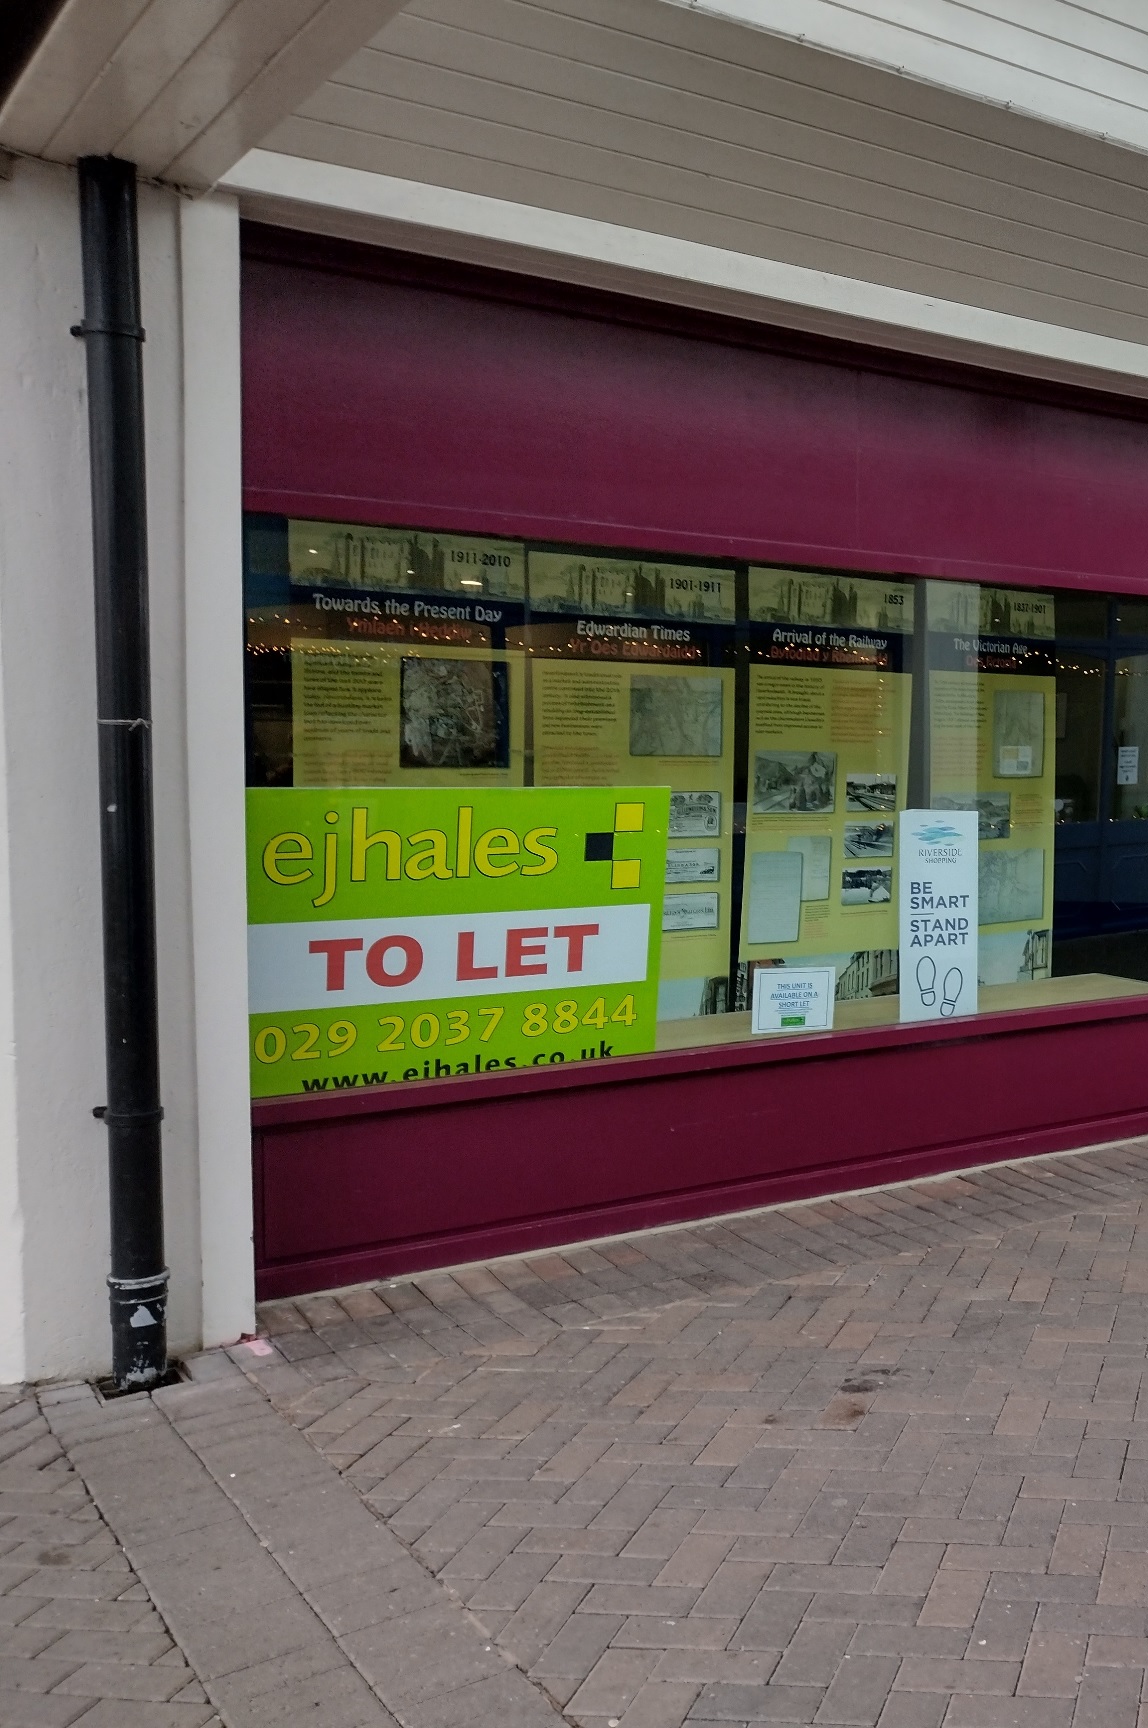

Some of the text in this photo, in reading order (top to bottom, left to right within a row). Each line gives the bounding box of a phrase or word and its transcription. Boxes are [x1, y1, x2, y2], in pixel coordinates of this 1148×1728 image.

[450, 550, 511, 568] 1911-2010
[669, 577, 722, 594] 1901-1911
[312, 592, 503, 623] Towards the Present Day
[884, 593, 904, 606] 1853
[1014, 601, 1047, 615] 1837-1901
[576, 619, 691, 642] Edwardian Times
[772, 627, 888, 650] Arrival of the Railway
[953, 637, 1028, 655] The Victorian Age
[261, 805, 560, 908] ejhales
[918, 848, 962, 857] RIVERSIDE
[910, 881, 933, 895] BE
[910, 894, 970, 910] SMART
[910, 917, 969, 933] STAND
[910, 932, 969, 948] APART
[308, 923, 600, 992] TO LET
[253, 993, 638, 1065] 029 2037 8844
